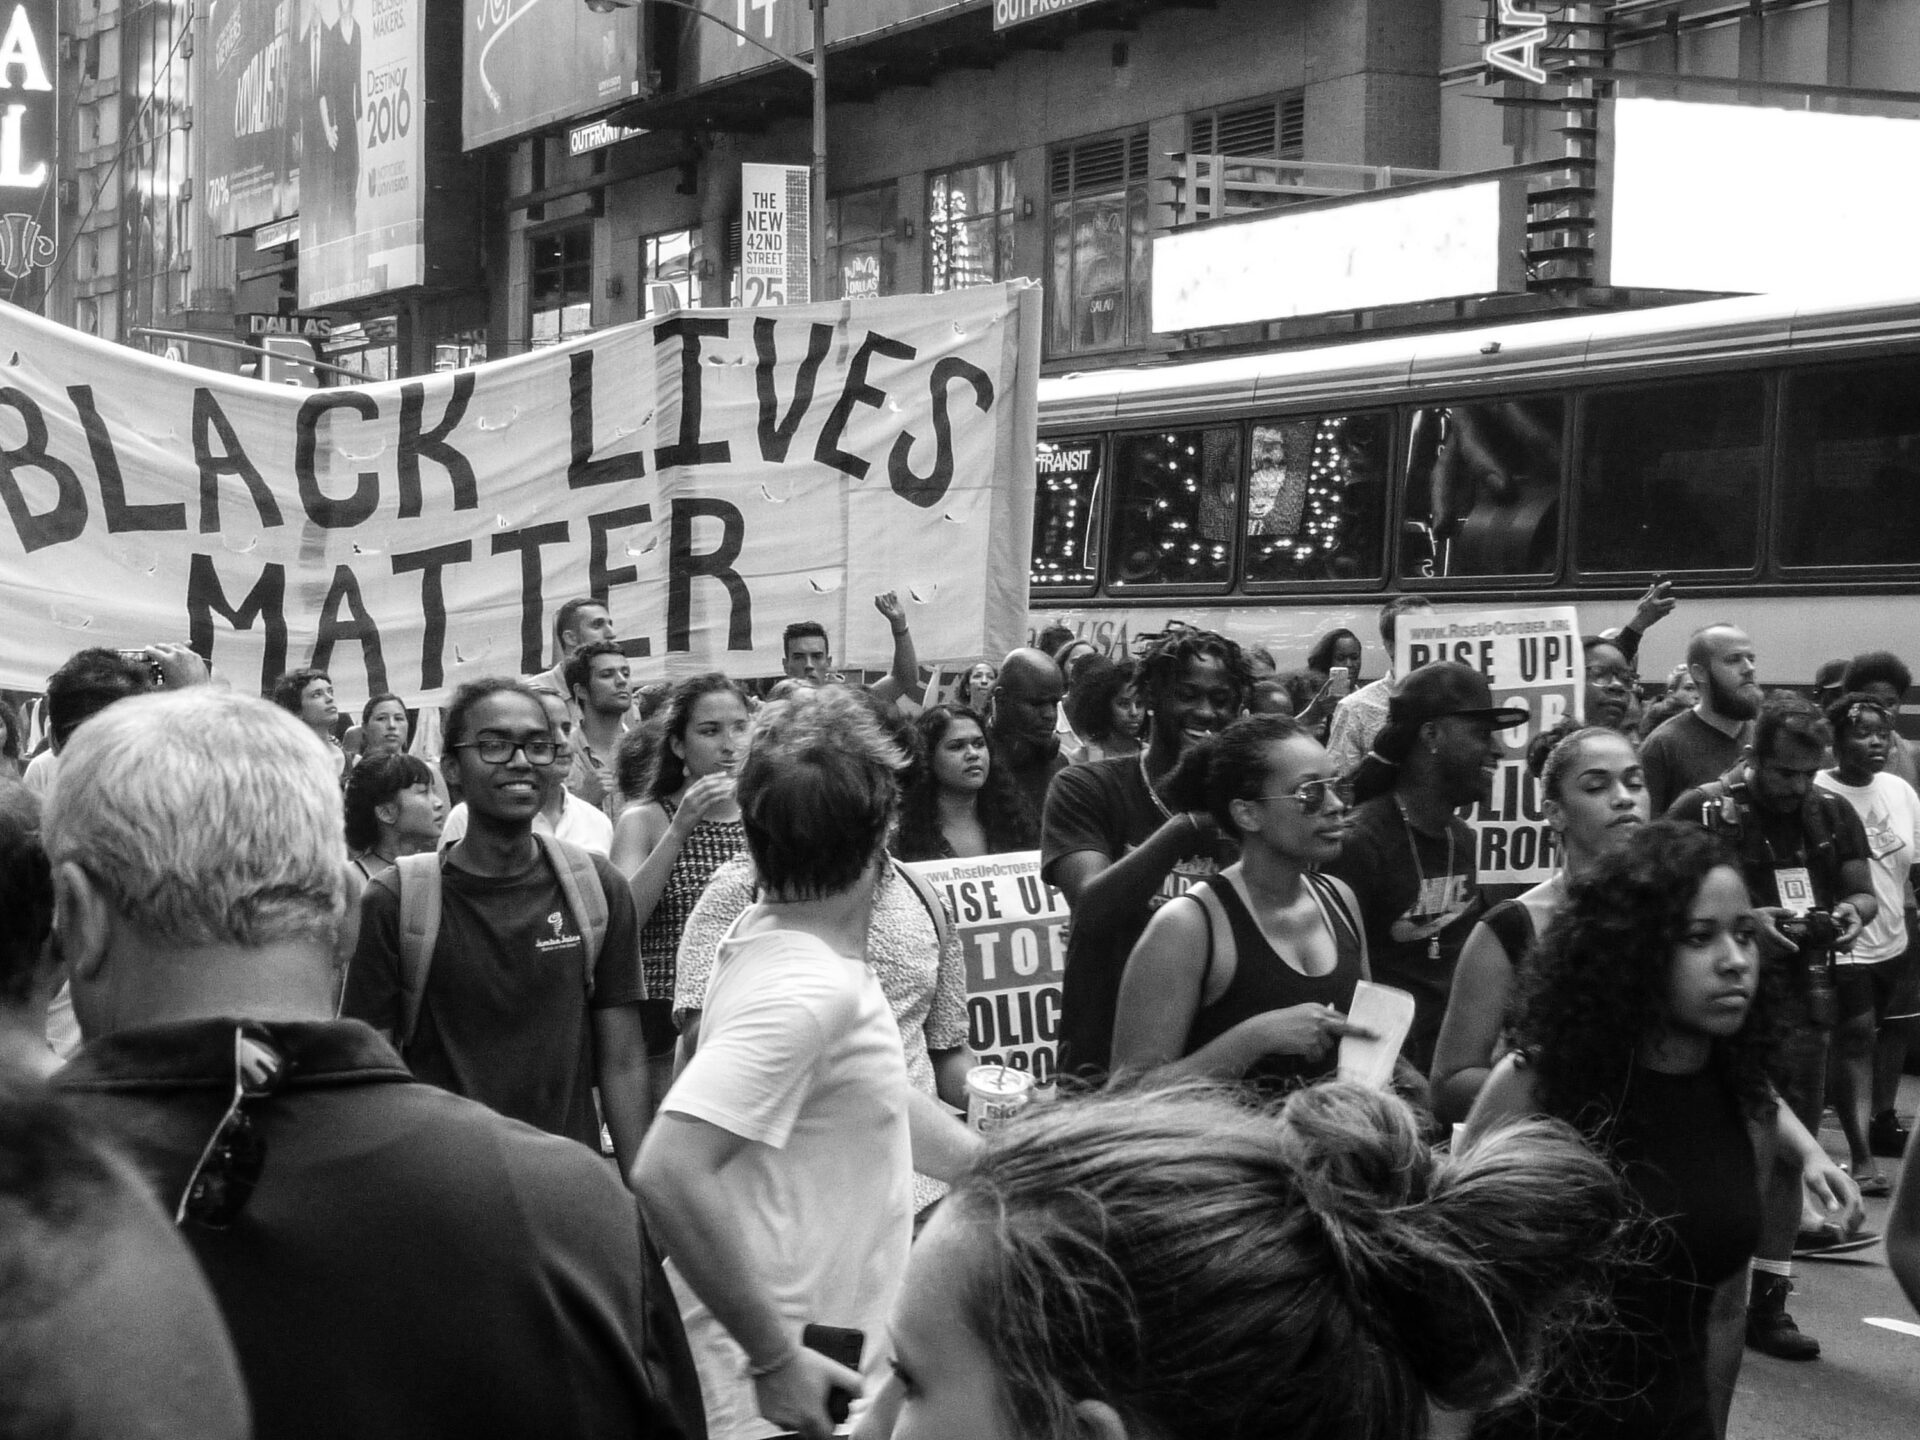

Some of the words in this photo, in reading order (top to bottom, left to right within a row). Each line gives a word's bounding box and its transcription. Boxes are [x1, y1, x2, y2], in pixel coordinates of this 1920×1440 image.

[367, 67, 411, 149] 2016
[209, 175, 230, 209] 70%
[752, 192, 777, 209] THE
[747, 210, 783, 232] NEW
[746, 233, 783, 251] 42ND
[746, 251, 784, 265] STREET
[746, 266, 784, 276] CELEBRATES
[745, 276, 785, 307] 25
[251, 315, 332, 336] DALLAS
[0, 372, 479, 553] BLACK
[567, 316, 994, 509] LIVES
[1037, 449, 1092, 473] TRANSIT
[186, 497, 753, 699] MATTER
[1518, 634, 1574, 682] UP!
[944, 881, 1003, 924] ISE
[973, 923, 1068, 980] TOP
[967, 987, 1063, 1052] OLIC
